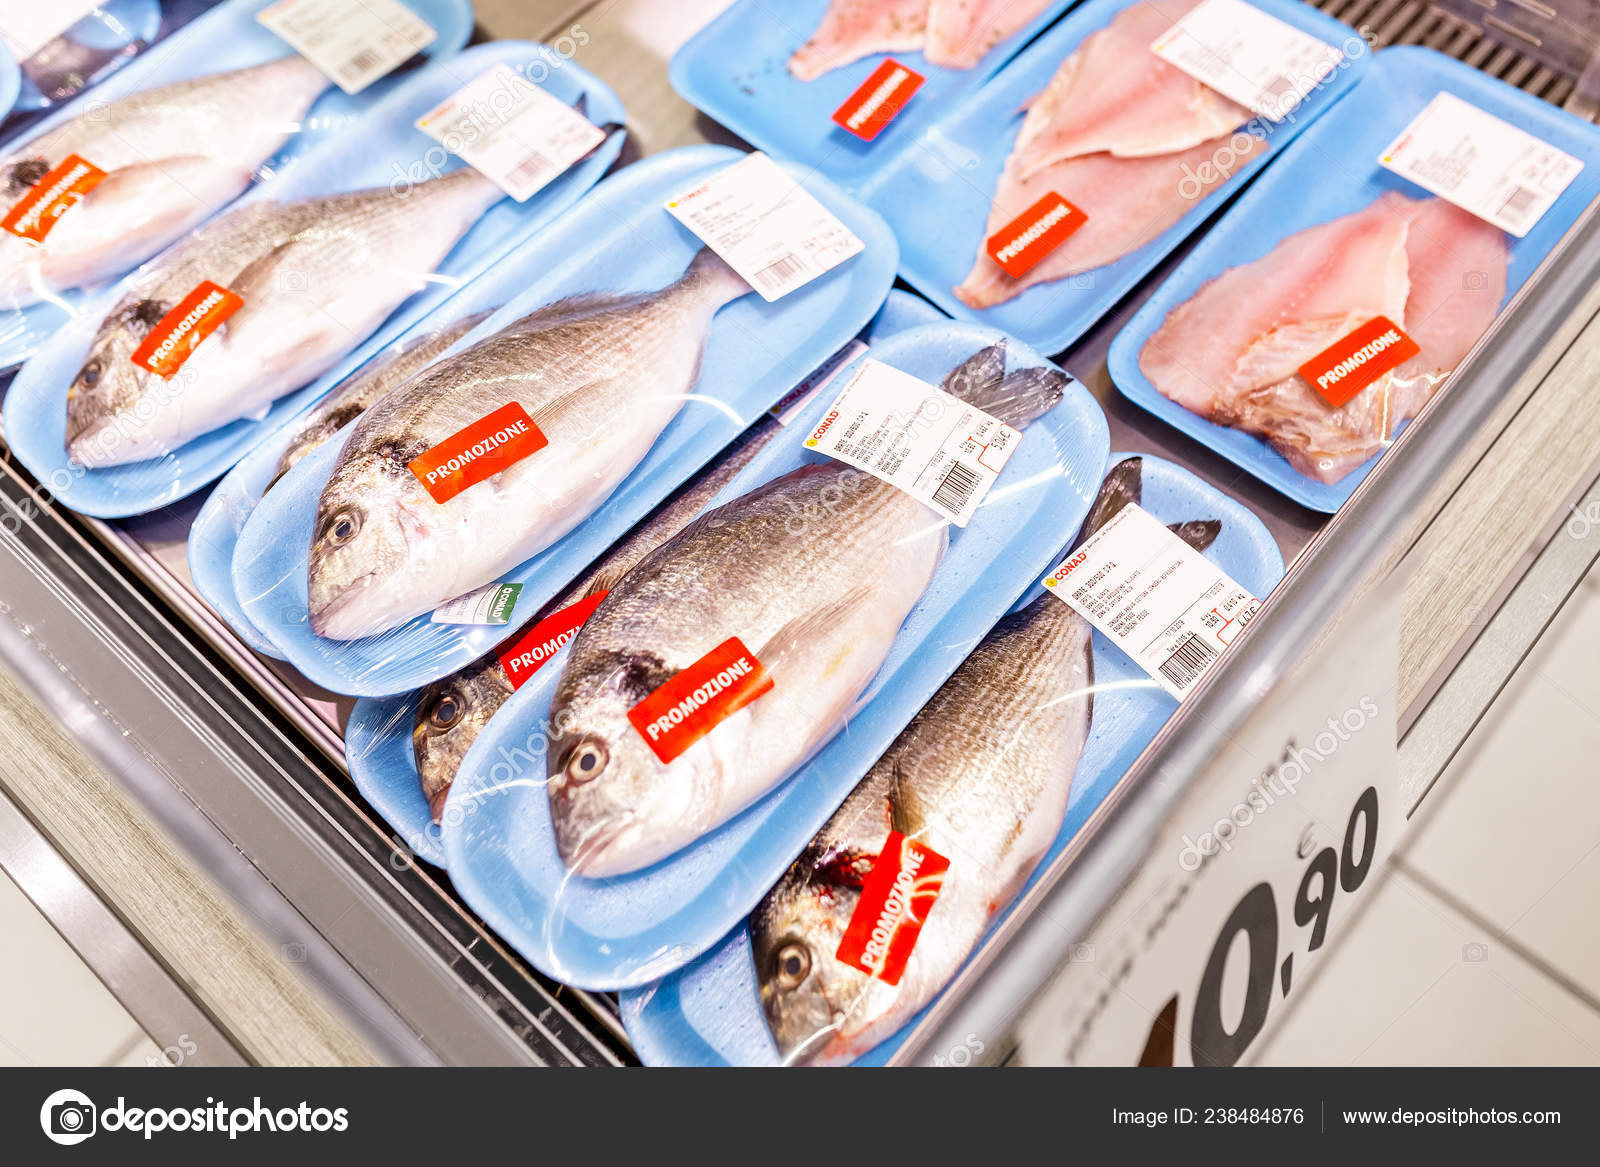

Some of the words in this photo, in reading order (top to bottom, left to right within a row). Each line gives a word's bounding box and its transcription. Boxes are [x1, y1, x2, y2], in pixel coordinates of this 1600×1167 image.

[996, 201, 1073, 264] PROMOZIONE
[147, 289, 225, 368] PROMOZIONE
[1316, 329, 1402, 390] PROMOZIONE
[425, 417, 530, 486] PROMOZIONE
[813, 410, 839, 440] CONAD
[1054, 552, 1087, 581] CONAD
[493, 593, 510, 618] CONAD
[1166, 642, 1178, 653] Tara
[647, 655, 755, 742] PROMOZIONE
[860, 848, 925, 969] PROMOZIONE
